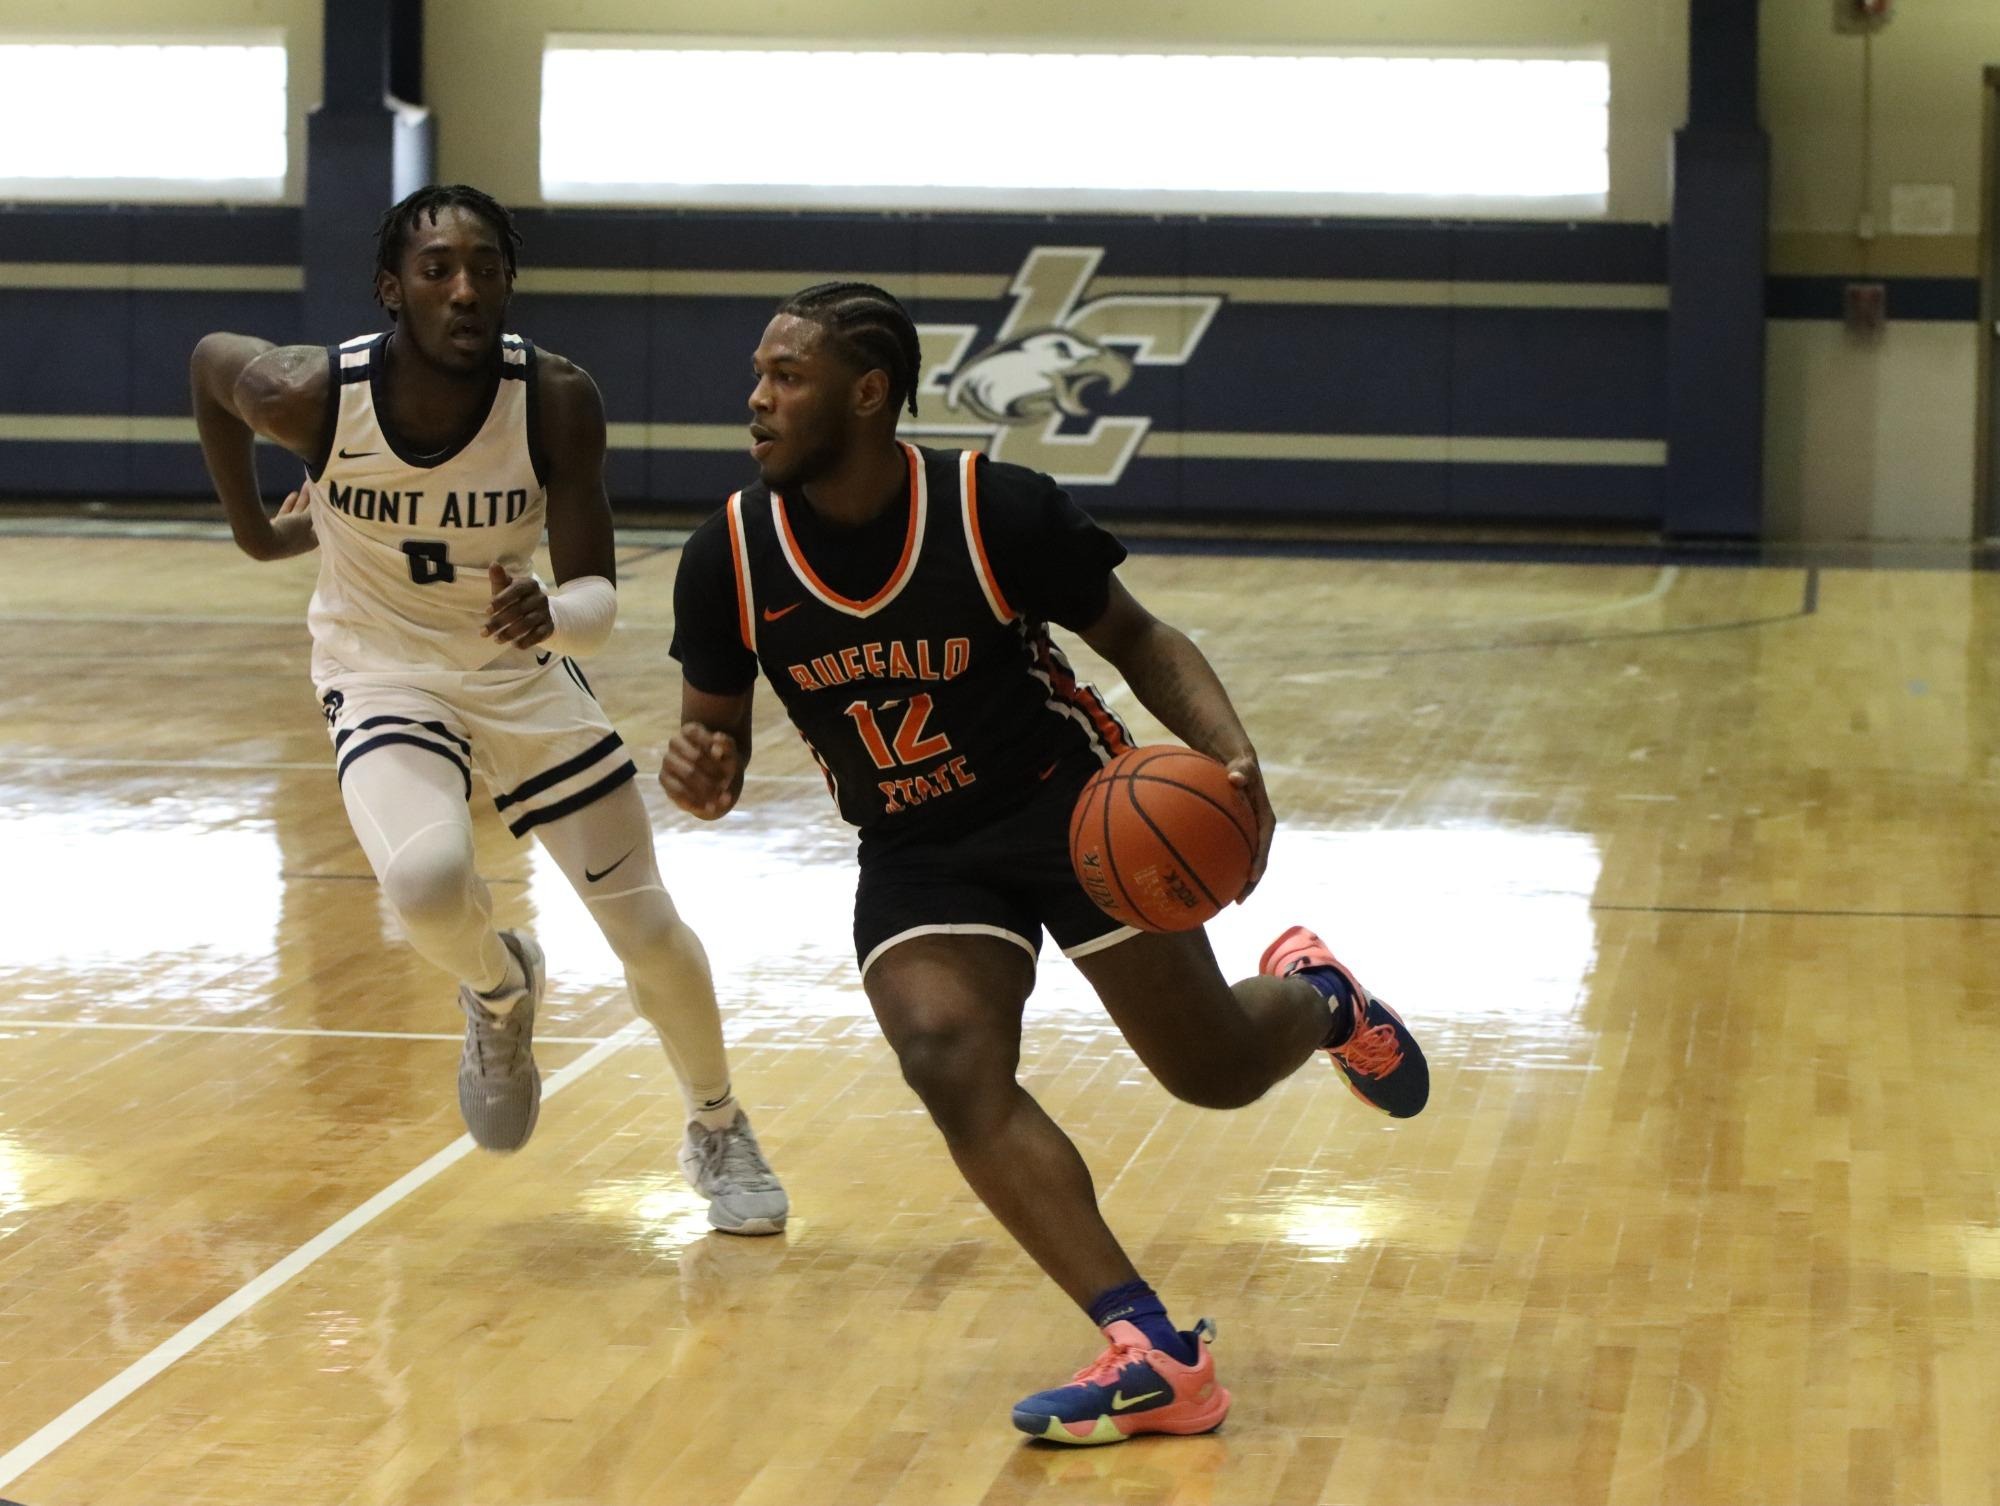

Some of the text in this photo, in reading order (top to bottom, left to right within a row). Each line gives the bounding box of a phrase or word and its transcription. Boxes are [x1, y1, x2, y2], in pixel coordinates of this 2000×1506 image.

[328, 479, 528, 529] MONT ALTO
[400, 538, 456, 586] 0
[787, 636, 971, 692] BUFFALO
[843, 691, 953, 771] 12
[877, 754, 977, 815] STATE
